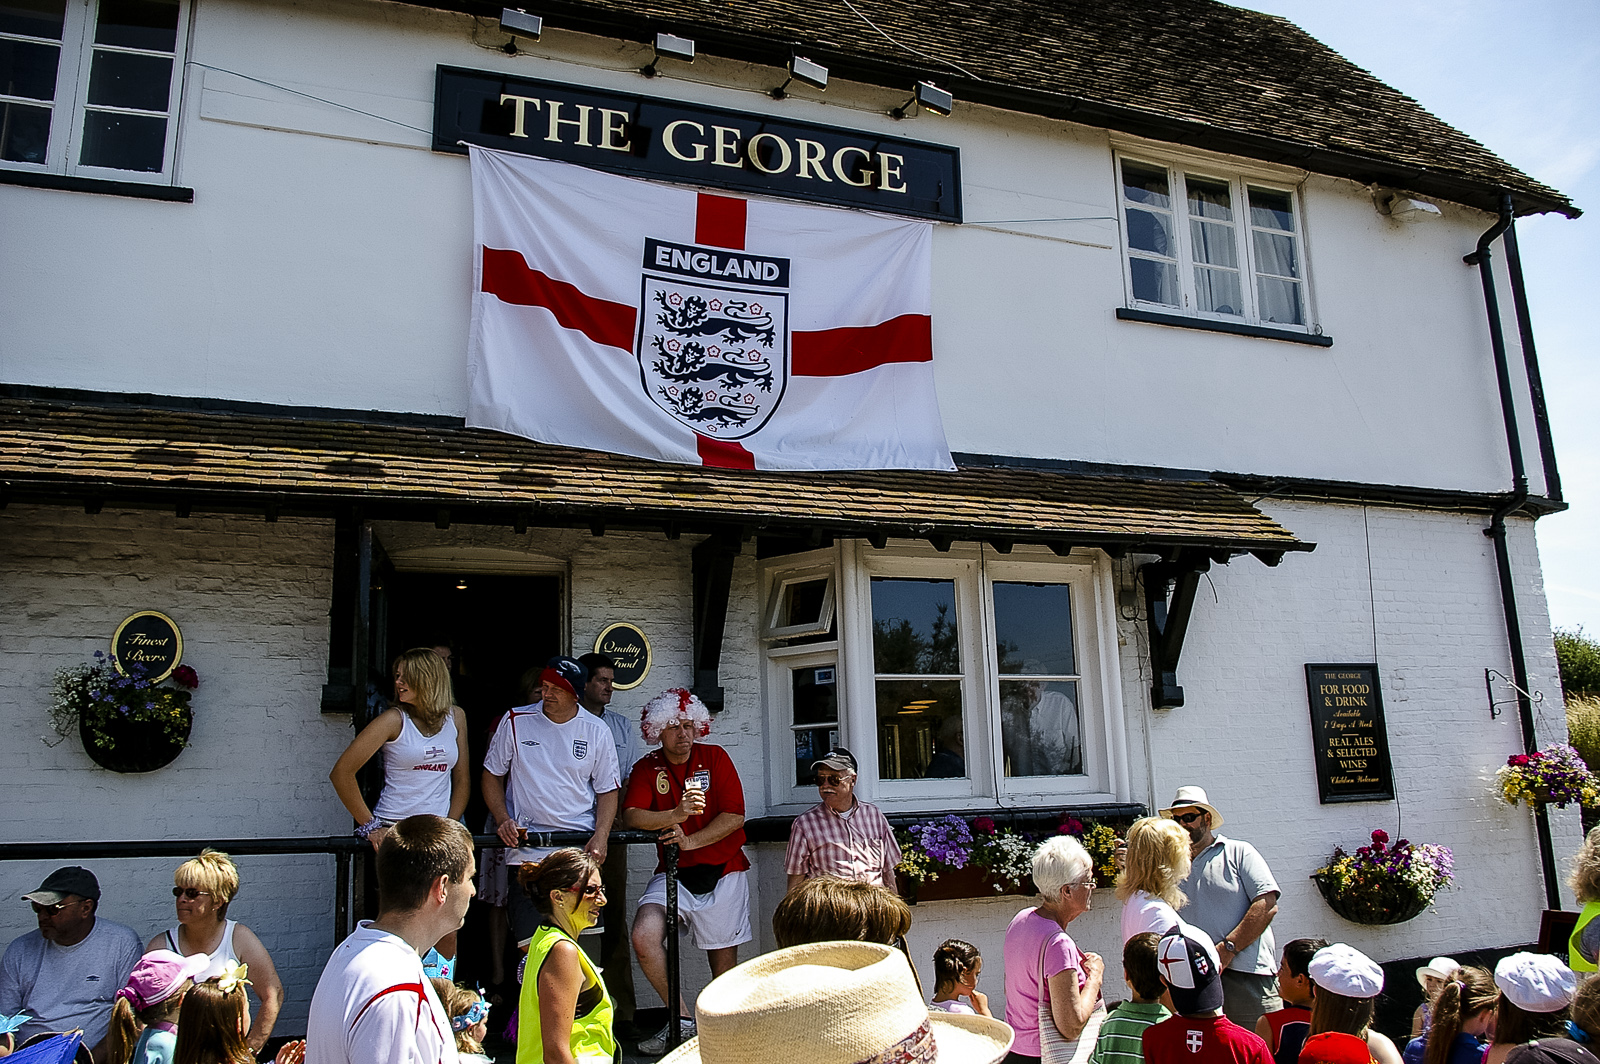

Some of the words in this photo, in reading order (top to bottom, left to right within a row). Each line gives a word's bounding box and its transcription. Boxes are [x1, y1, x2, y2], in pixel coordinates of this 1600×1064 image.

[499, 94, 631, 153] THE
[662, 119, 907, 194] GEORGE
[655, 245, 780, 281] ENGLAND
[125, 633, 169, 646] Finest
[603, 641, 641, 657] Quality
[125, 649, 167, 662] Beers
[613, 655, 644, 669] Food
[1320, 684, 1340, 695] FOR
[1342, 684, 1370, 695] FOOD
[1324, 696, 1333, 707] &
[1335, 696, 1368, 707] DRINK
[1333, 709, 1361, 717] Available
[1324, 720, 1329, 729] 7
[1330, 720, 1347, 731] Days
[1348, 720, 1356, 728] A
[1358, 720, 1373, 728] Week
[1329, 737, 1352, 747] REAL
[1353, 736, 1374, 746] ALES
[1327, 748, 1334, 758] &
[1336, 747, 1377, 758] SELECTED
[1339, 759, 1368, 769] WINES
[656, 771, 670, 795] 6
[1330, 776, 1355, 784] Children
[1356, 775, 1379, 783] Welcome
